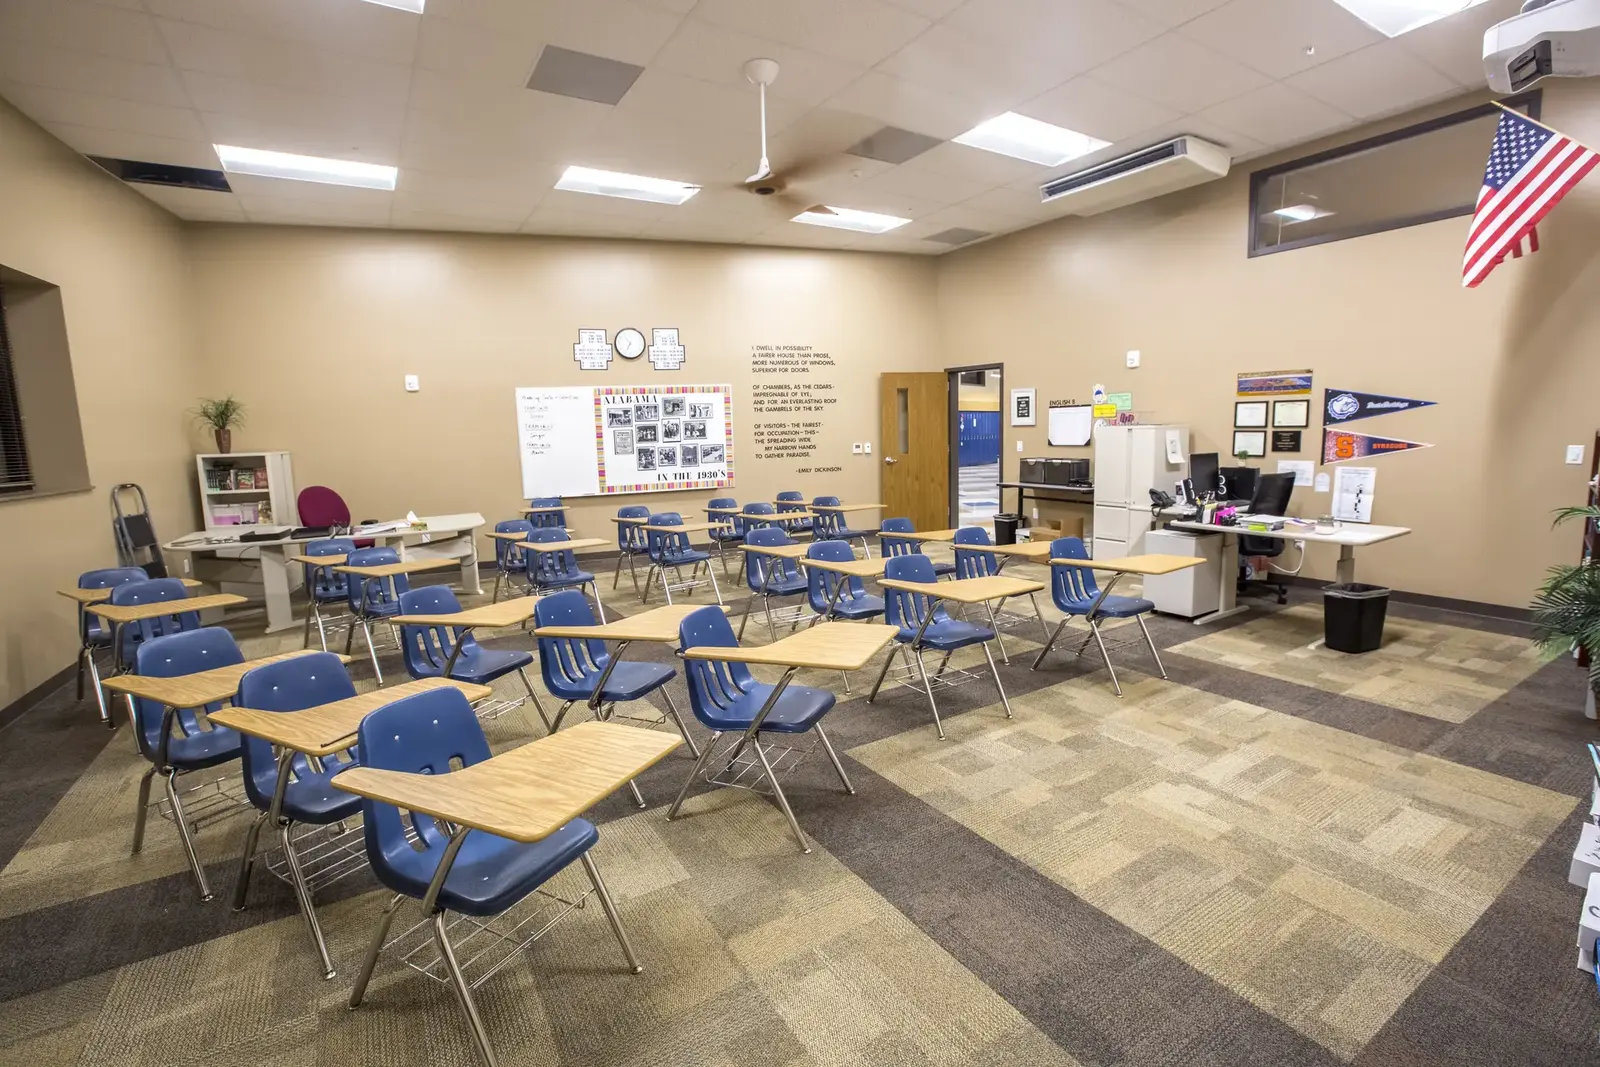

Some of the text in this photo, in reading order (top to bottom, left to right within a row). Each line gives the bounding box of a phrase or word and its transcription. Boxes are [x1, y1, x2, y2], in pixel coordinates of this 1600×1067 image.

[604, 395, 658, 404] ALABAMA
[1335, 436, 1354, 458] S
[657, 469, 725, 481] IN THE 1930'S
